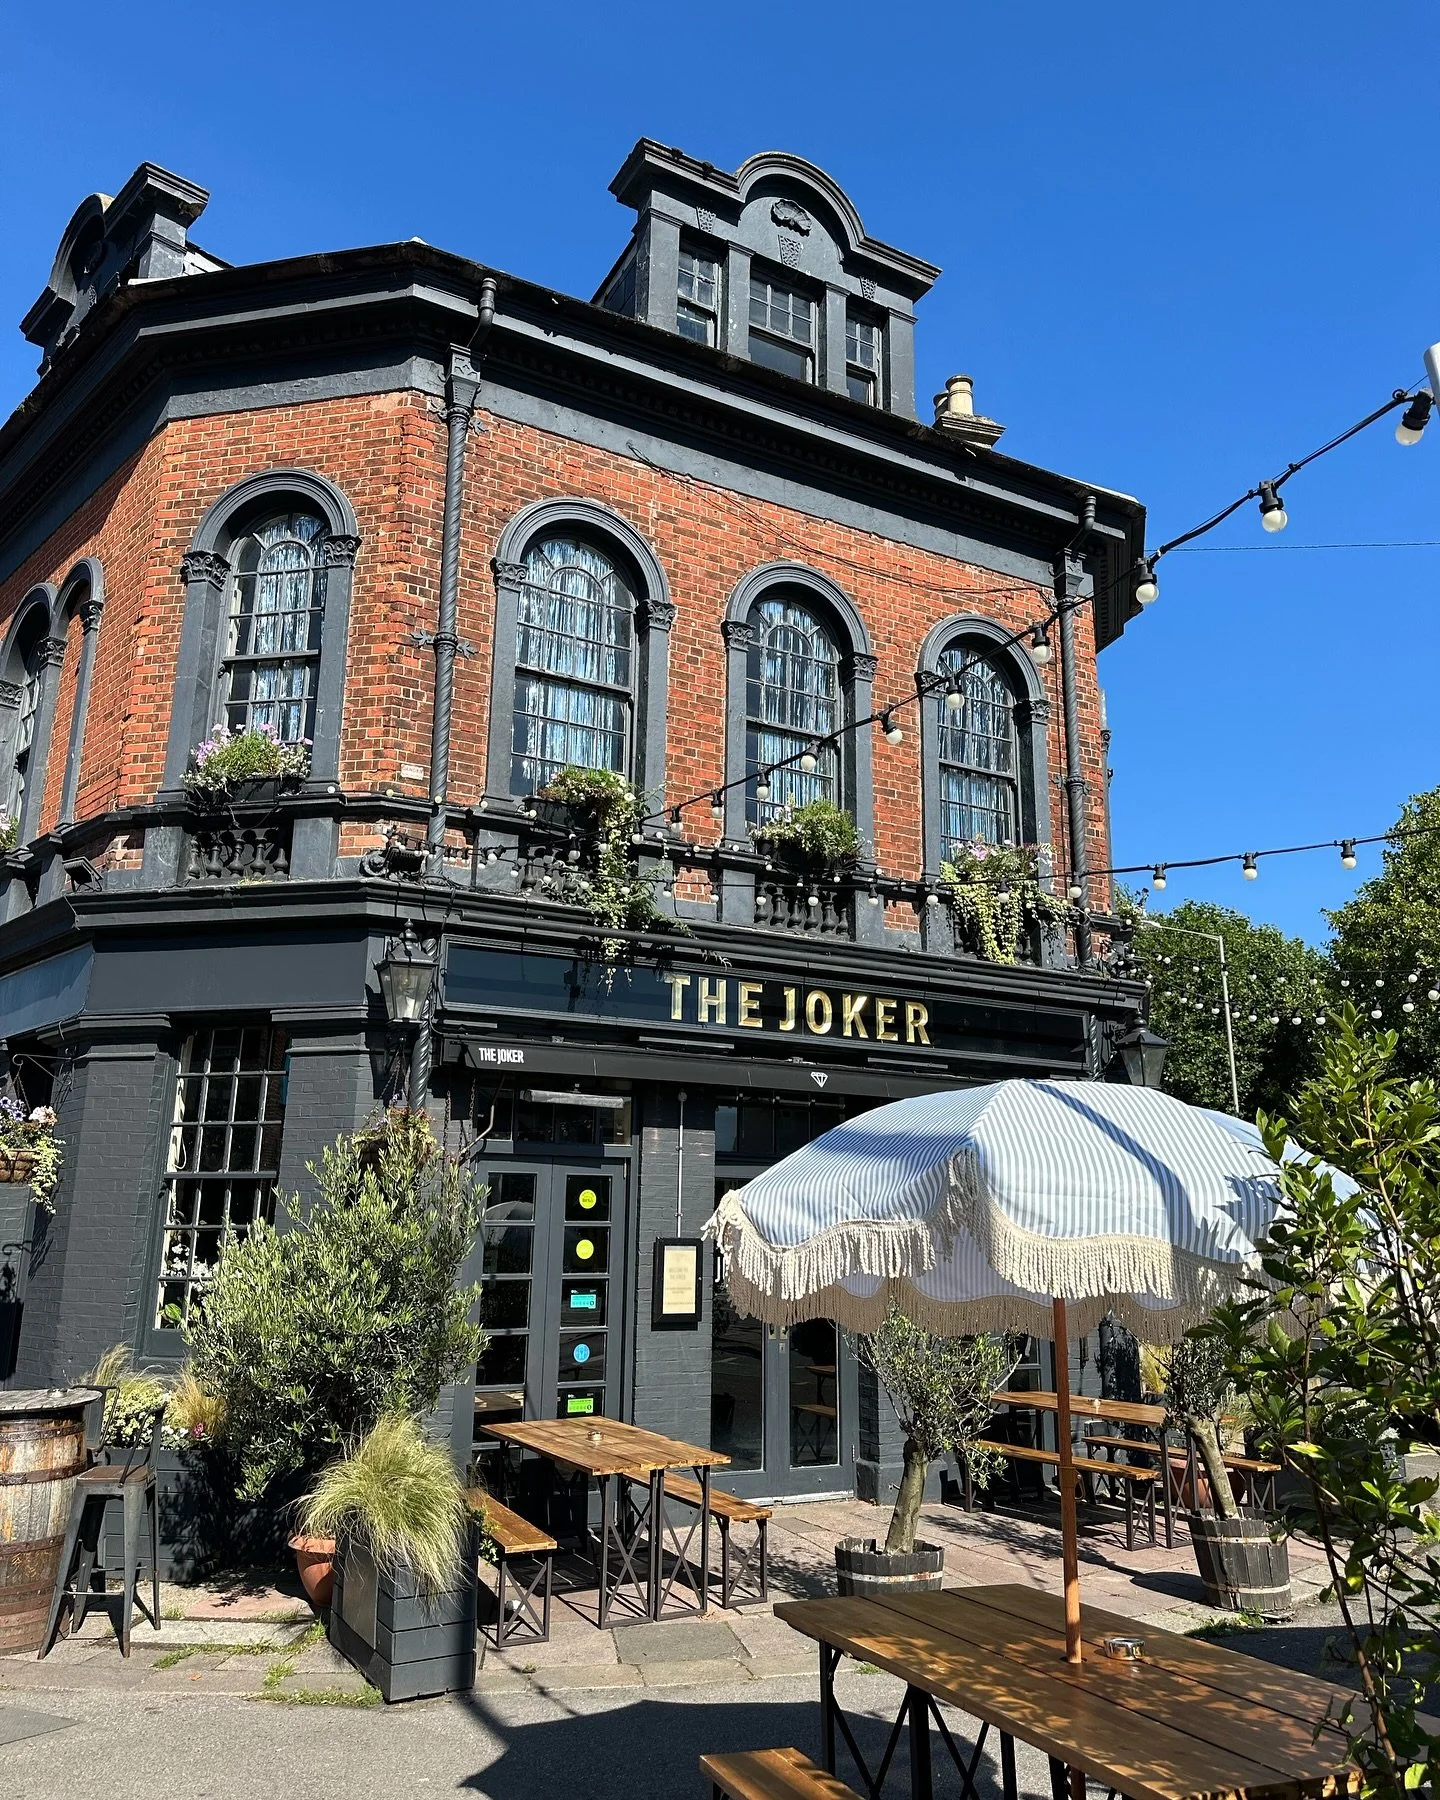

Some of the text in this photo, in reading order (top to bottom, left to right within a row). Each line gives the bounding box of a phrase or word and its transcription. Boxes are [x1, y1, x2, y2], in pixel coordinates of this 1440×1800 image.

[664, 974, 931, 1045] THE JOKER
[478, 1047, 524, 1065] THE JOKER
